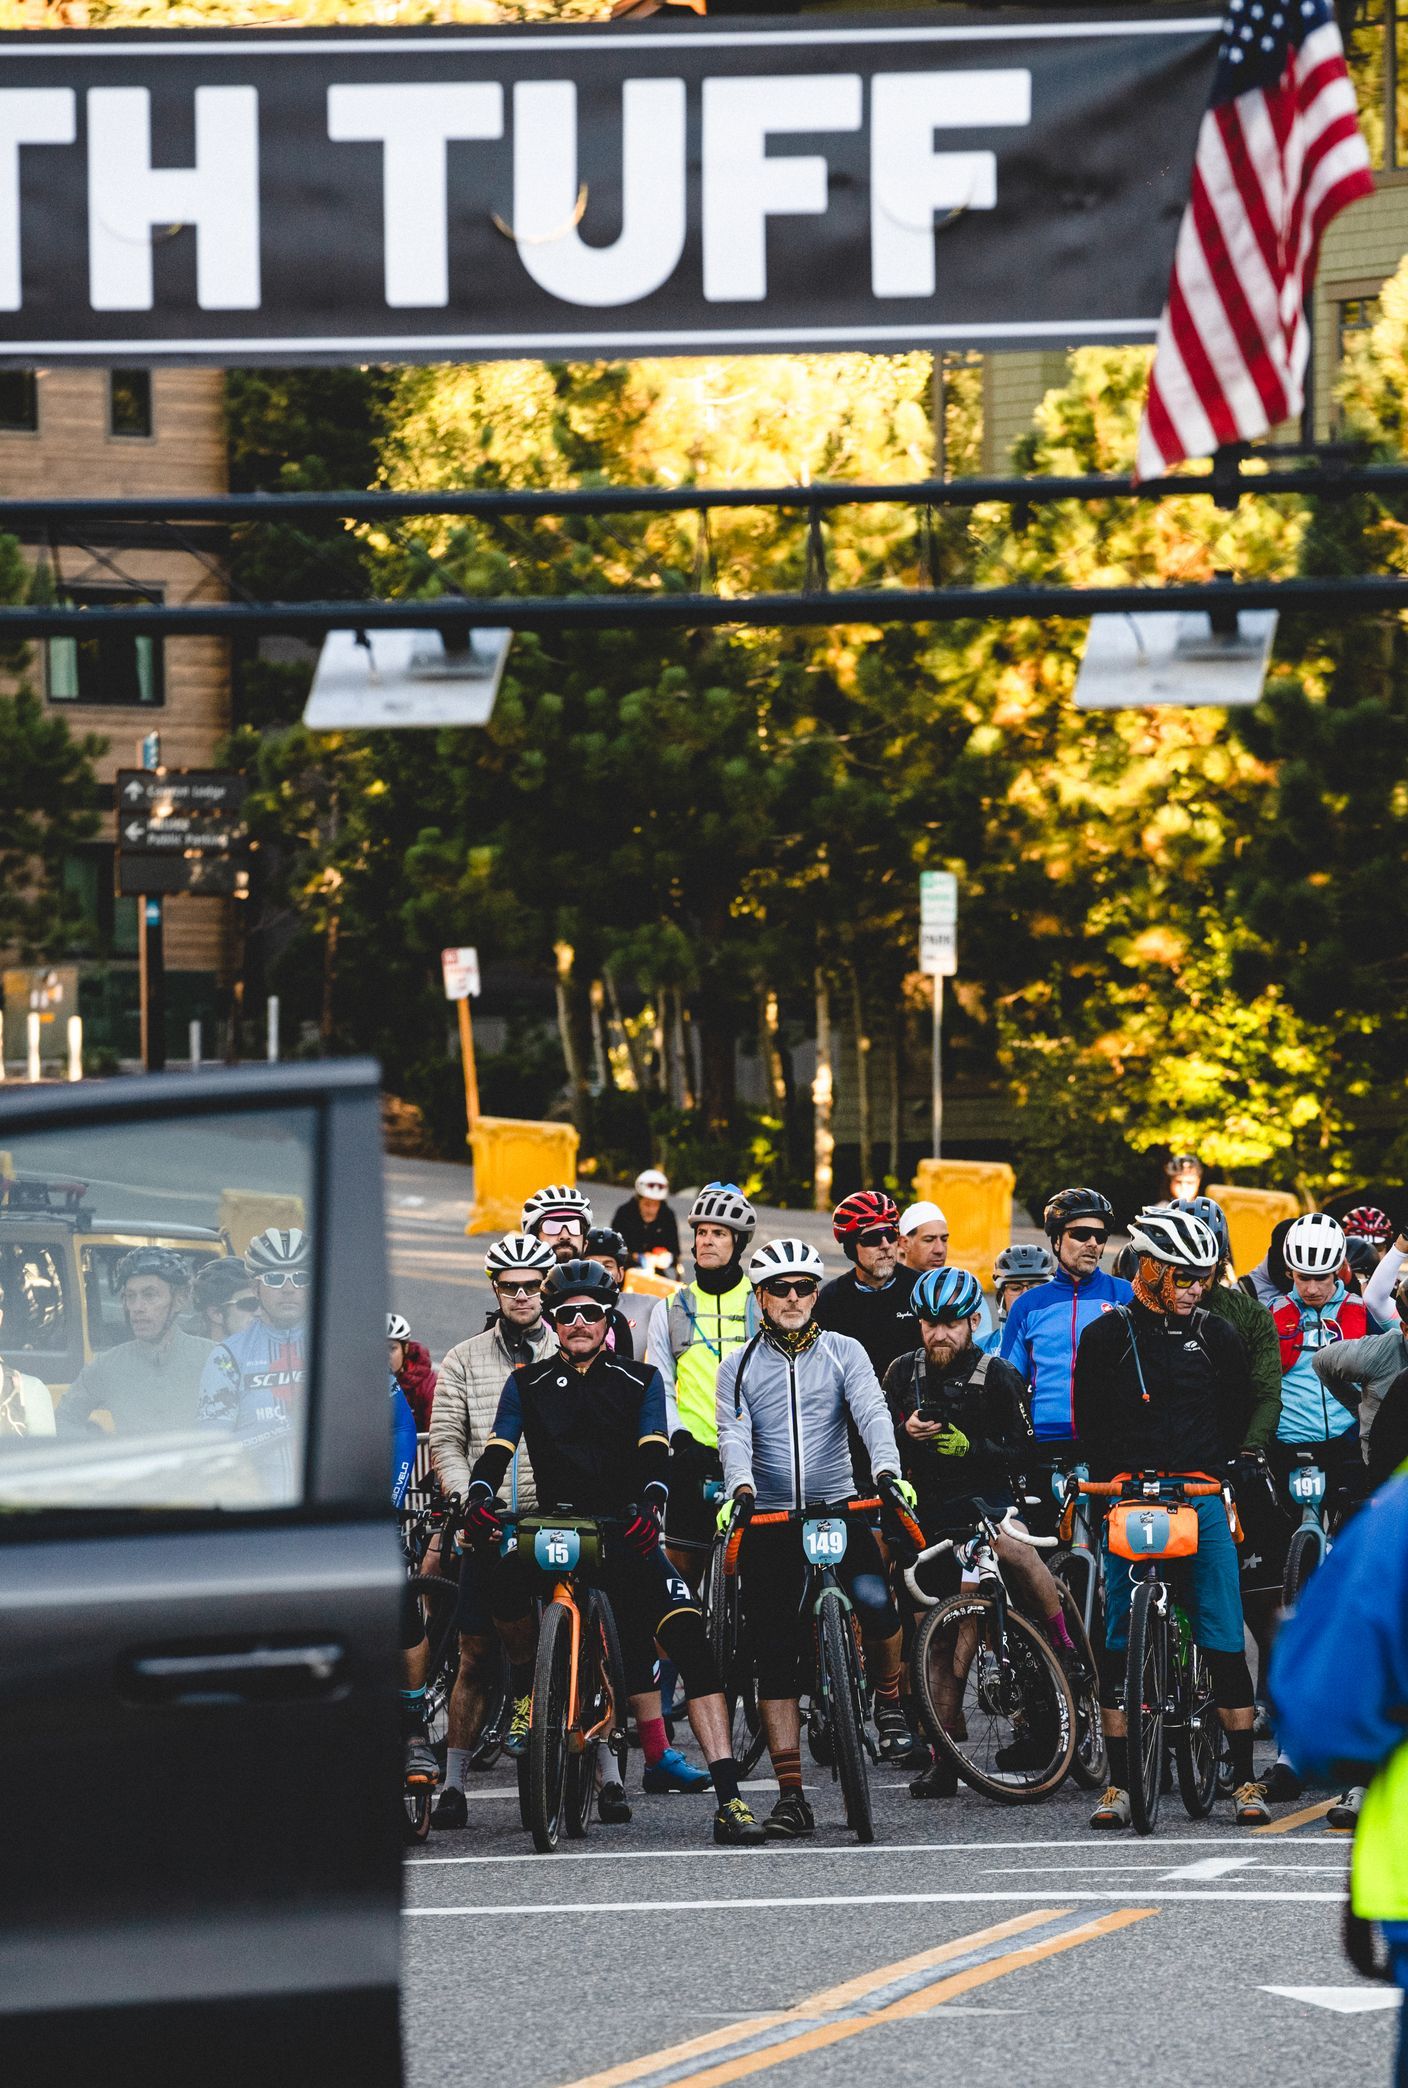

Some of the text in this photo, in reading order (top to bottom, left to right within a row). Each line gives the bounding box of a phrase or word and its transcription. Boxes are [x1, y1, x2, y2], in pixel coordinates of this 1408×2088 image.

[327, 68, 1032, 307] TUFF
[396, 1461, 409, 1485] VELO
[1293, 1477, 1321, 1497] 191
[807, 1532, 843, 1554] 149
[1142, 1523, 1153, 1545] 1
[545, 1543, 569, 1564] 15
